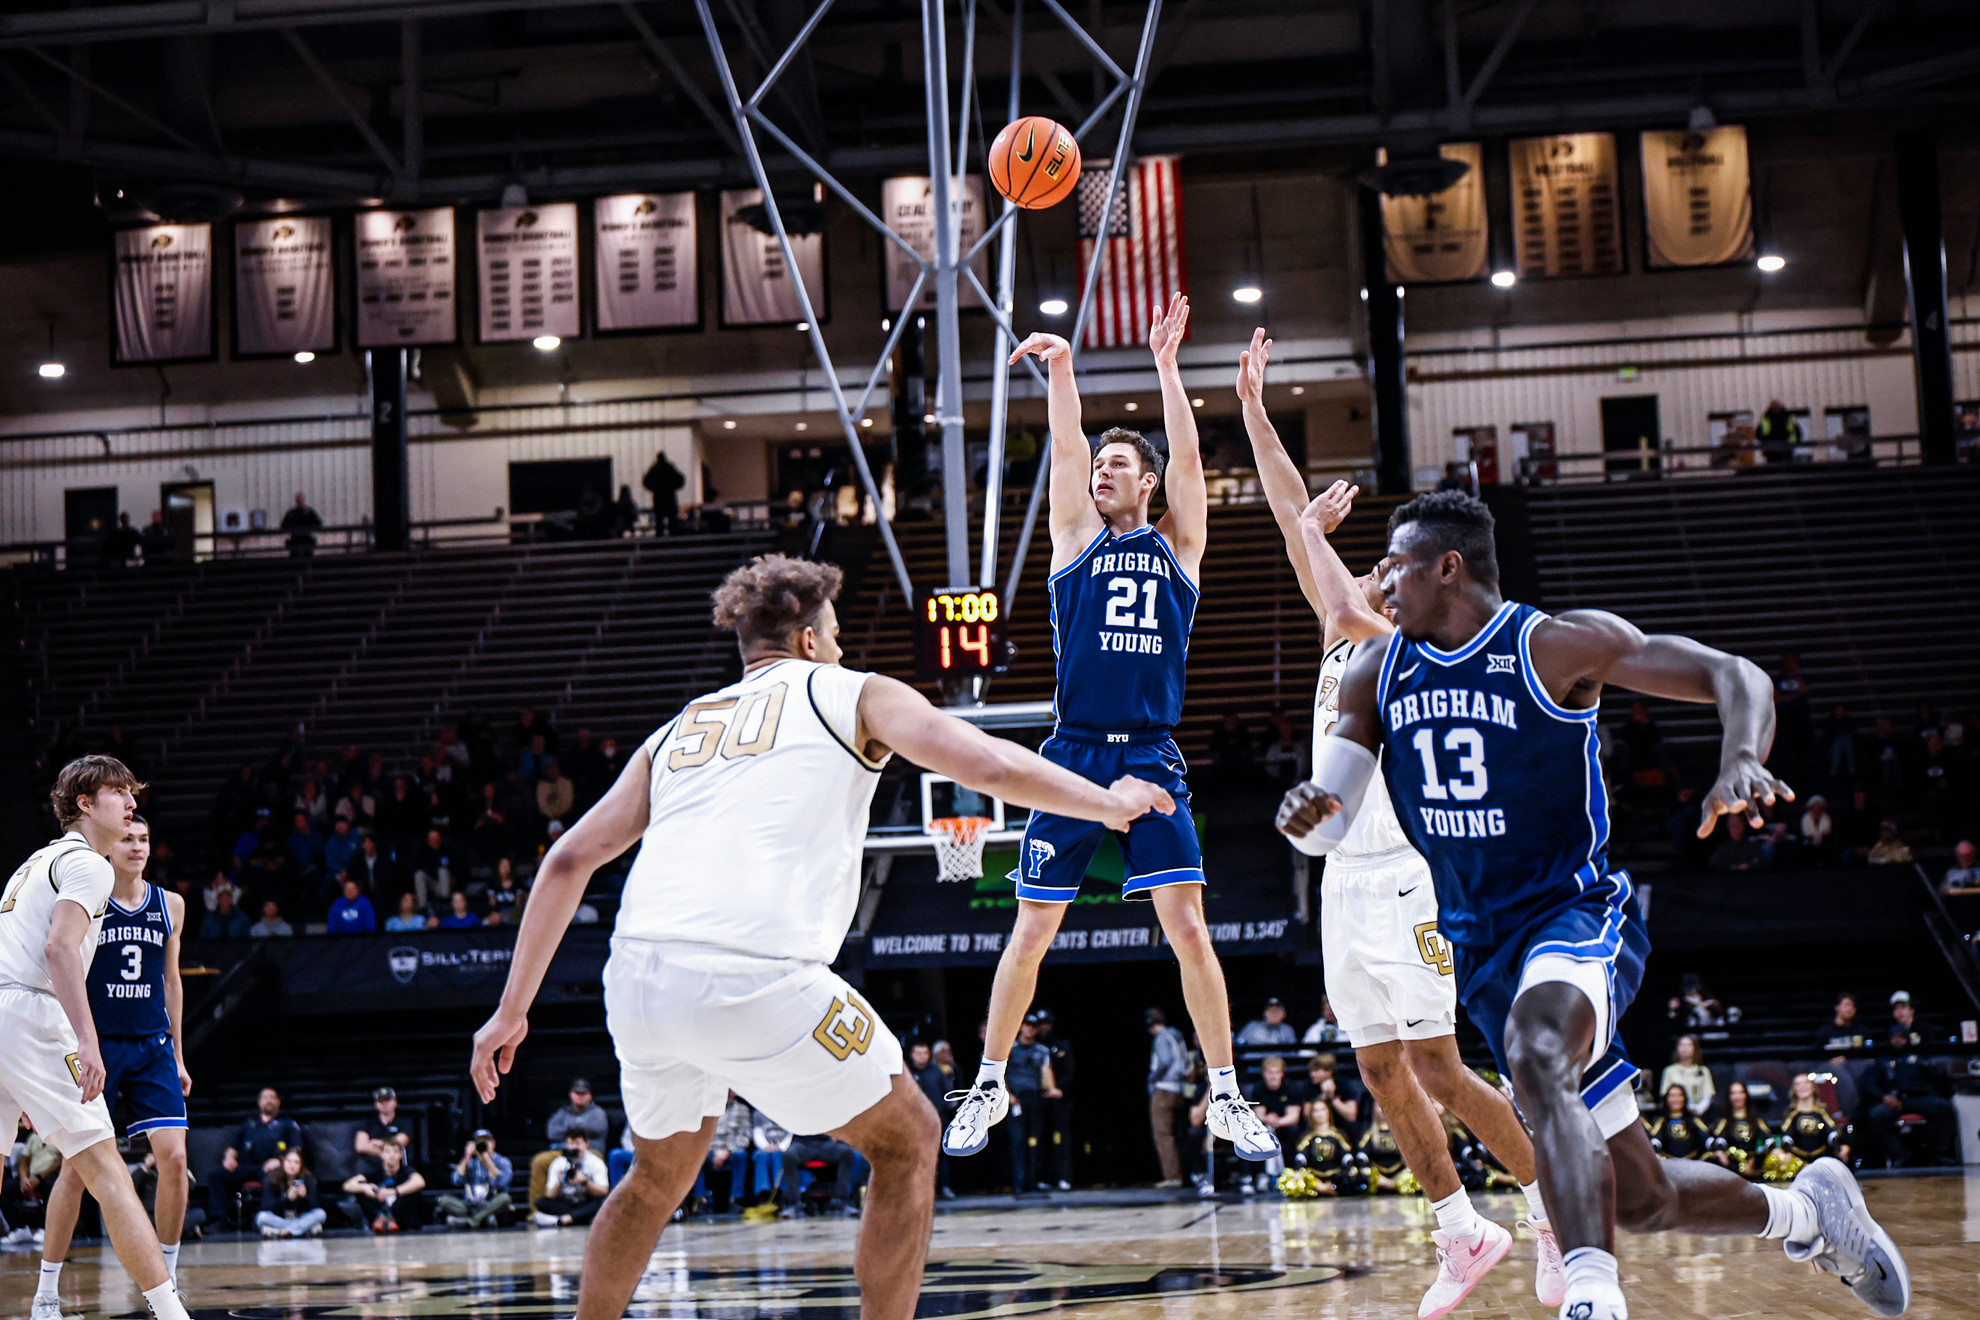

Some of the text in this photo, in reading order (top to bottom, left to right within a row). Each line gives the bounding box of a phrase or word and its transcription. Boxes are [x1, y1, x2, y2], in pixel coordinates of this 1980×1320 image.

[1044, 132, 1072, 178] ELITE
[927, 592, 998, 623] 17:00
[1105, 577, 1159, 630] 21
[940, 624, 989, 669] 14
[1099, 632, 1163, 654] YOUNG
[667, 681, 789, 772] 50
[1389, 689, 1518, 732] BRIGHAM
[1107, 733, 1129, 744] BYU
[1413, 727, 1489, 801] 13
[1419, 808, 1507, 838] YOUNG
[97, 926, 164, 947] BRIGHAM
[872, 934, 947, 955] WELCOME
[950, 934, 970, 952] TO
[973, 934, 1002, 952] THE
[1091, 927, 1150, 949] CENTER
[120, 945, 142, 981] 3
[106, 983, 152, 998] YOUNG
